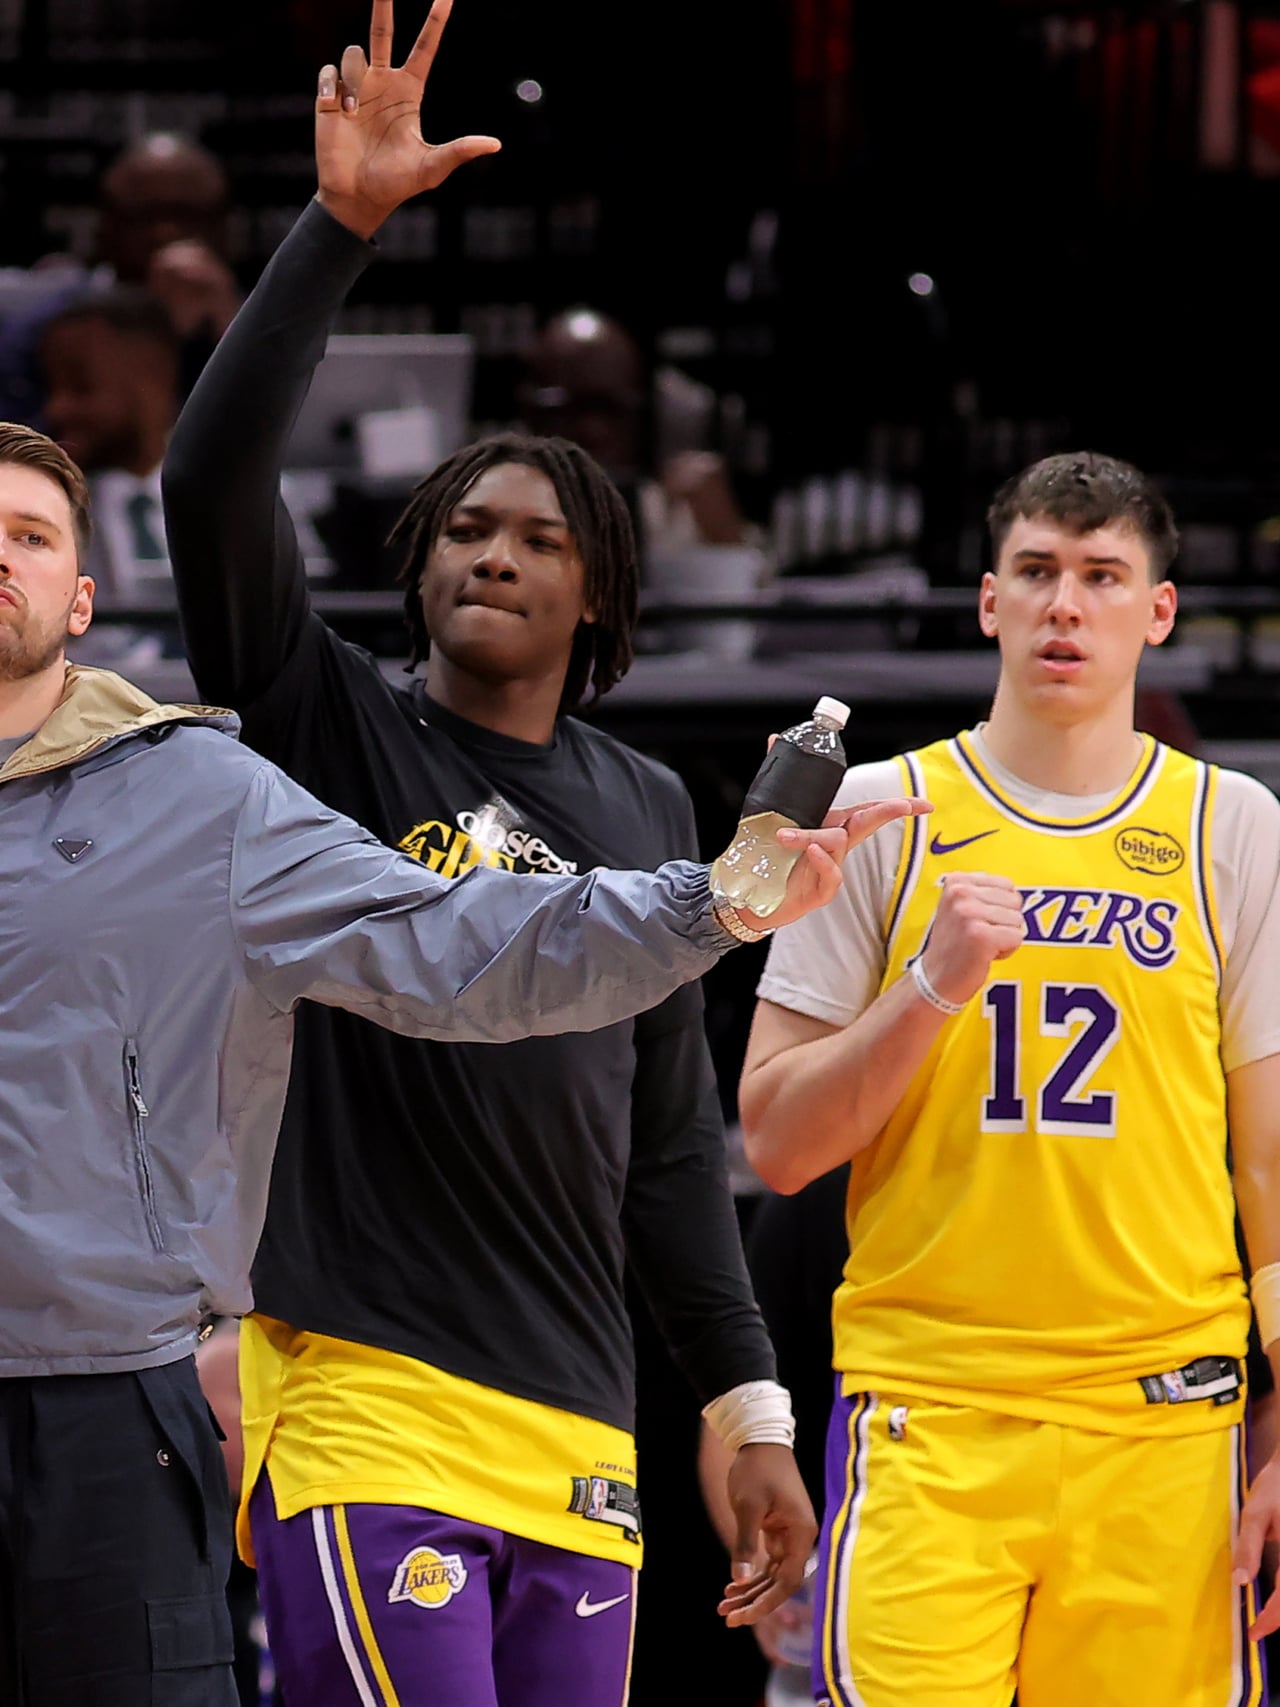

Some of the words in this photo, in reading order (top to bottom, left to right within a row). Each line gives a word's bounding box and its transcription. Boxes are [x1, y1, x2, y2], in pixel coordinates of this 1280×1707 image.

[1121, 836, 1180, 863] bibigo
[981, 979, 1122, 1139] 12
[393, 1565, 460, 1598] LAKERS
